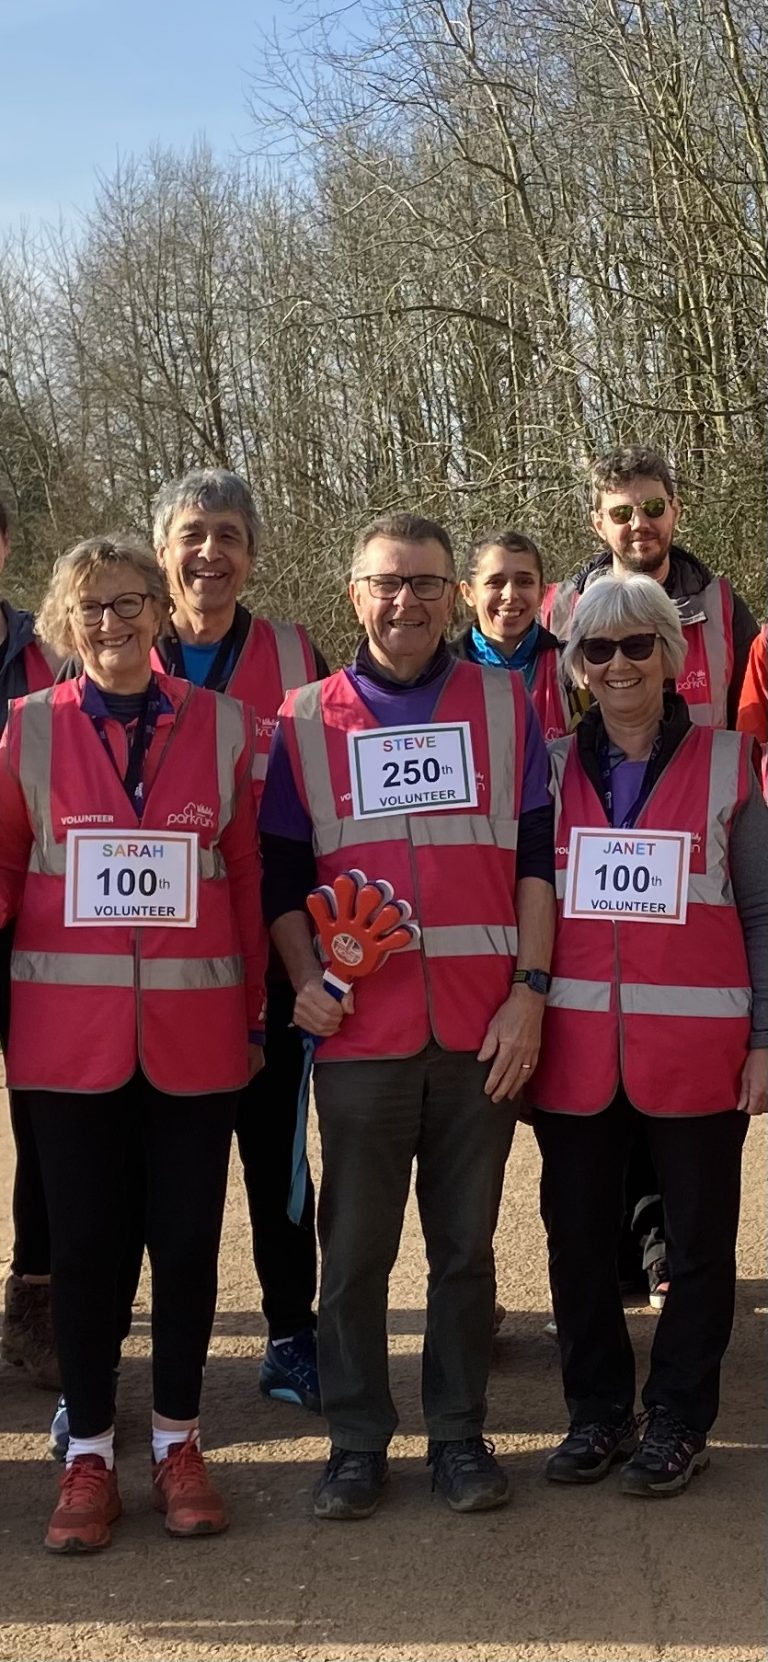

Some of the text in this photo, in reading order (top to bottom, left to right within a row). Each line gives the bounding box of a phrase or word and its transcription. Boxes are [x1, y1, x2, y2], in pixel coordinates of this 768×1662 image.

[383, 736, 437, 752] STEVE
[382, 758, 453, 788] 250th
[379, 790, 456, 807] VOLUNTEER
[61, 815, 114, 825] VOLUNTEER
[167, 806, 214, 828] parkrun
[102, 844, 164, 858] SARAH
[603, 841, 656, 856] JANET
[96, 868, 170, 897] 100th
[595, 864, 662, 893] 100th
[94, 906, 176, 917] VOLUNTEER
[591, 899, 667, 913] VOLUNTEER
